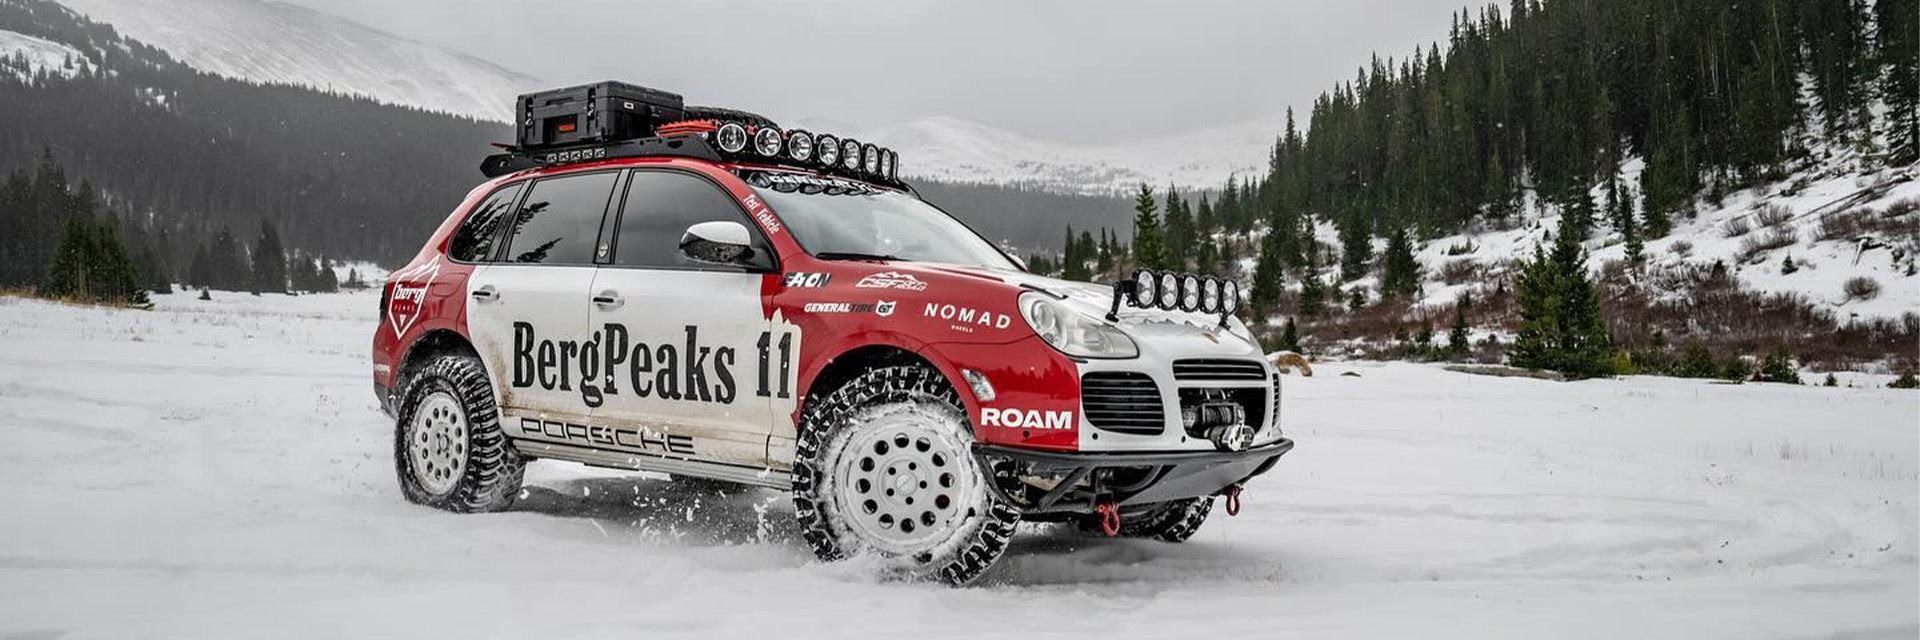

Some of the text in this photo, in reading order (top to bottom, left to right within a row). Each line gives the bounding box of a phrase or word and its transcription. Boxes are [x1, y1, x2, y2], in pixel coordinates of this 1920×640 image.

[744, 194, 780, 234] Test Vehicle
[394, 283, 425, 304] berg
[804, 303, 850, 313] GENERAL
[924, 303, 1011, 329] NOMAD
[512, 321, 792, 408] BergPeaks 11
[980, 407, 1073, 430] ROAM
[520, 417, 696, 455] PORSCHE
